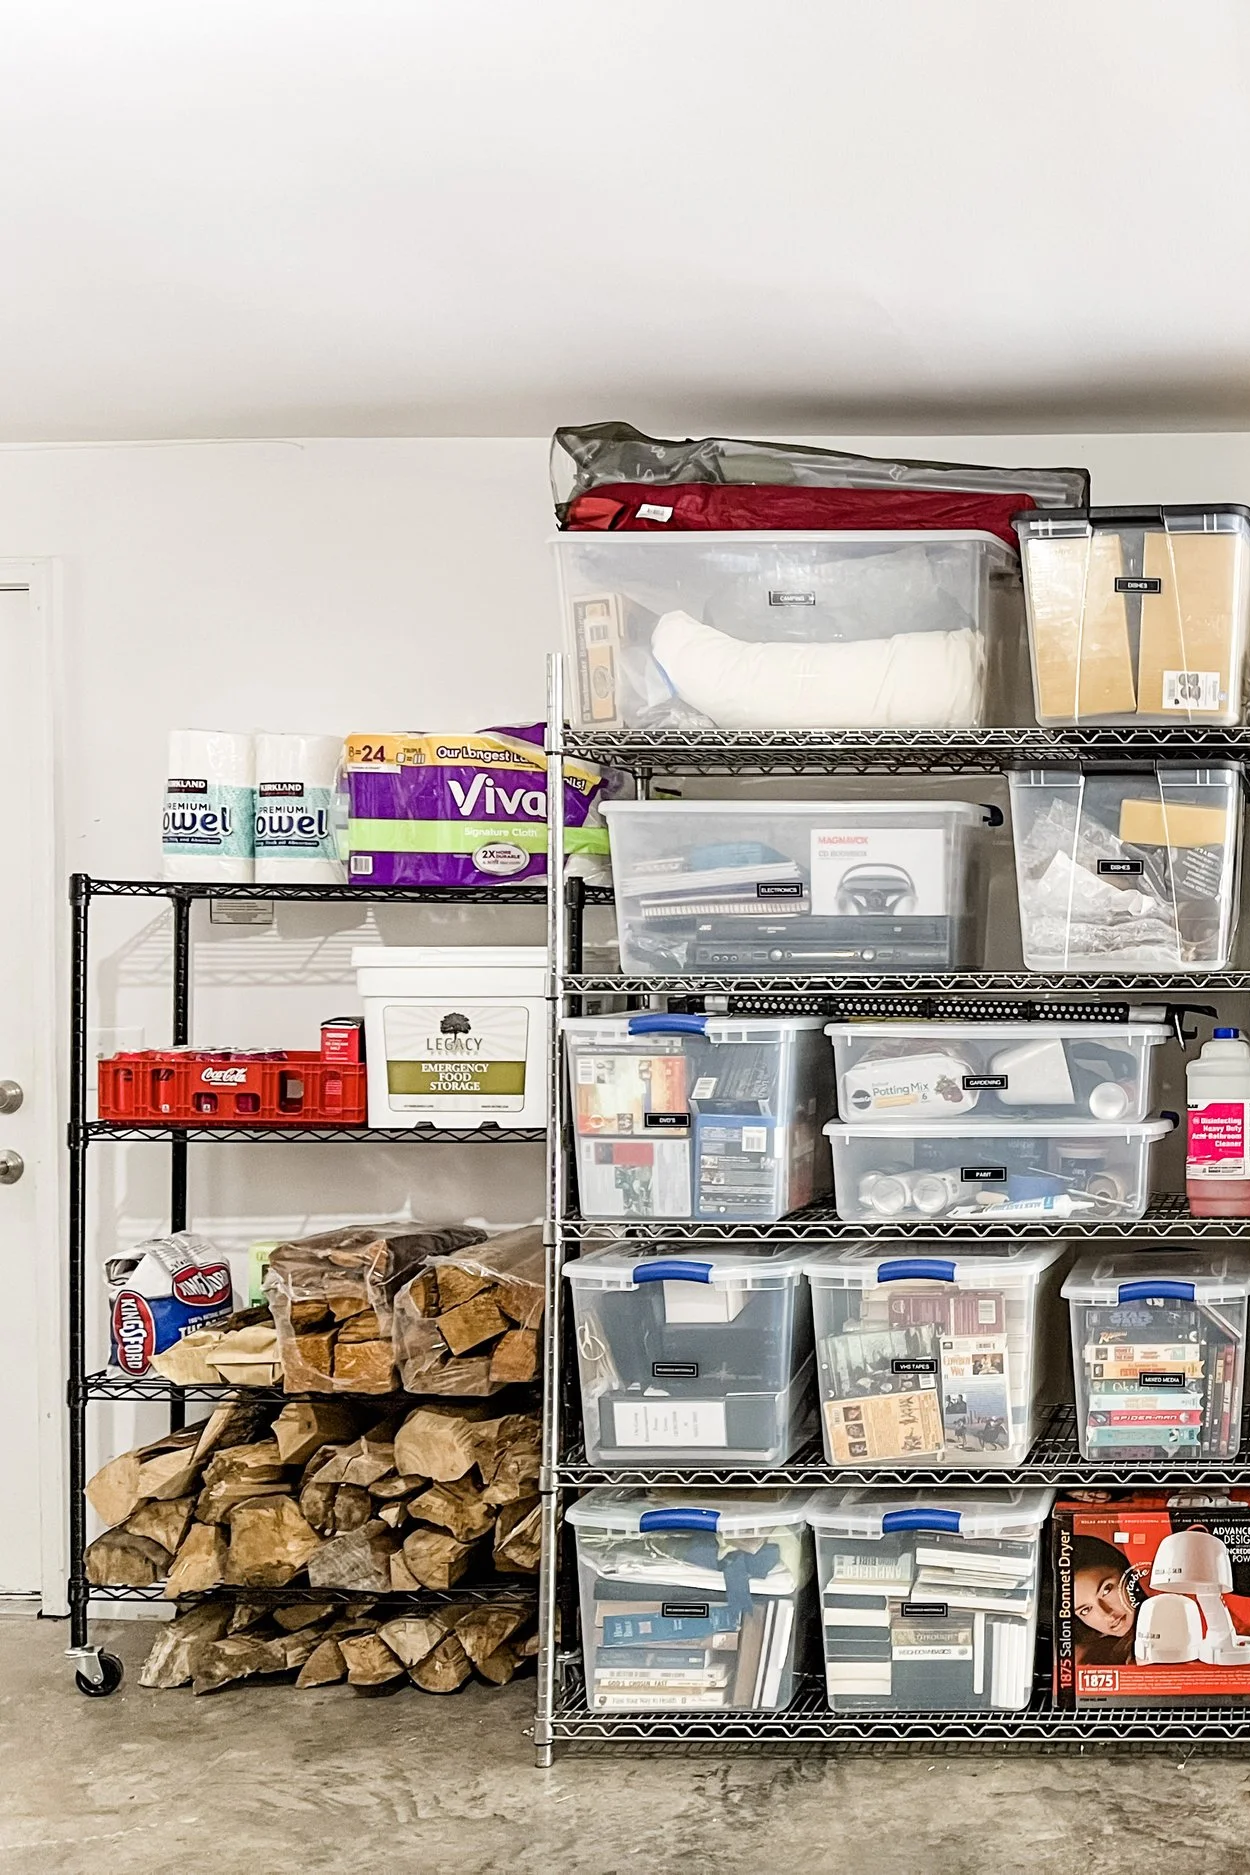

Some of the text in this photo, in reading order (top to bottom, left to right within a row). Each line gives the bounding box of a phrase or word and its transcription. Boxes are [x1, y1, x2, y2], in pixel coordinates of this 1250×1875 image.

[437, 746, 458, 758] Our
[462, 748, 510, 762] Longest
[260, 784, 303, 792] KIRKLAND
[448, 772, 547, 817] Viva
[464, 827, 537, 837] Signature Cloth
[818, 835, 869, 845] MAGNAVOX
[482, 850, 496, 859] 2X
[426, 1037, 483, 1051] LEGACY
[421, 1063, 489, 1073] EMERGENCY
[439, 1072, 472, 1082] FOOD
[429, 1081, 481, 1091] STORAGE
[872, 1081, 930, 1097] Potting Mix
[1200, 1117, 1242, 1126] Disinfecting
[1203, 1125, 1243, 1133] Heavy Duty
[119, 1298, 147, 1369] KINGSFORD
[1113, 1414, 1178, 1422] SPIDER-MAN
[1058, 1529, 1074, 1689] 1875 Salon Bonnet Dryer
[1083, 1674, 1113, 1688] 1875
